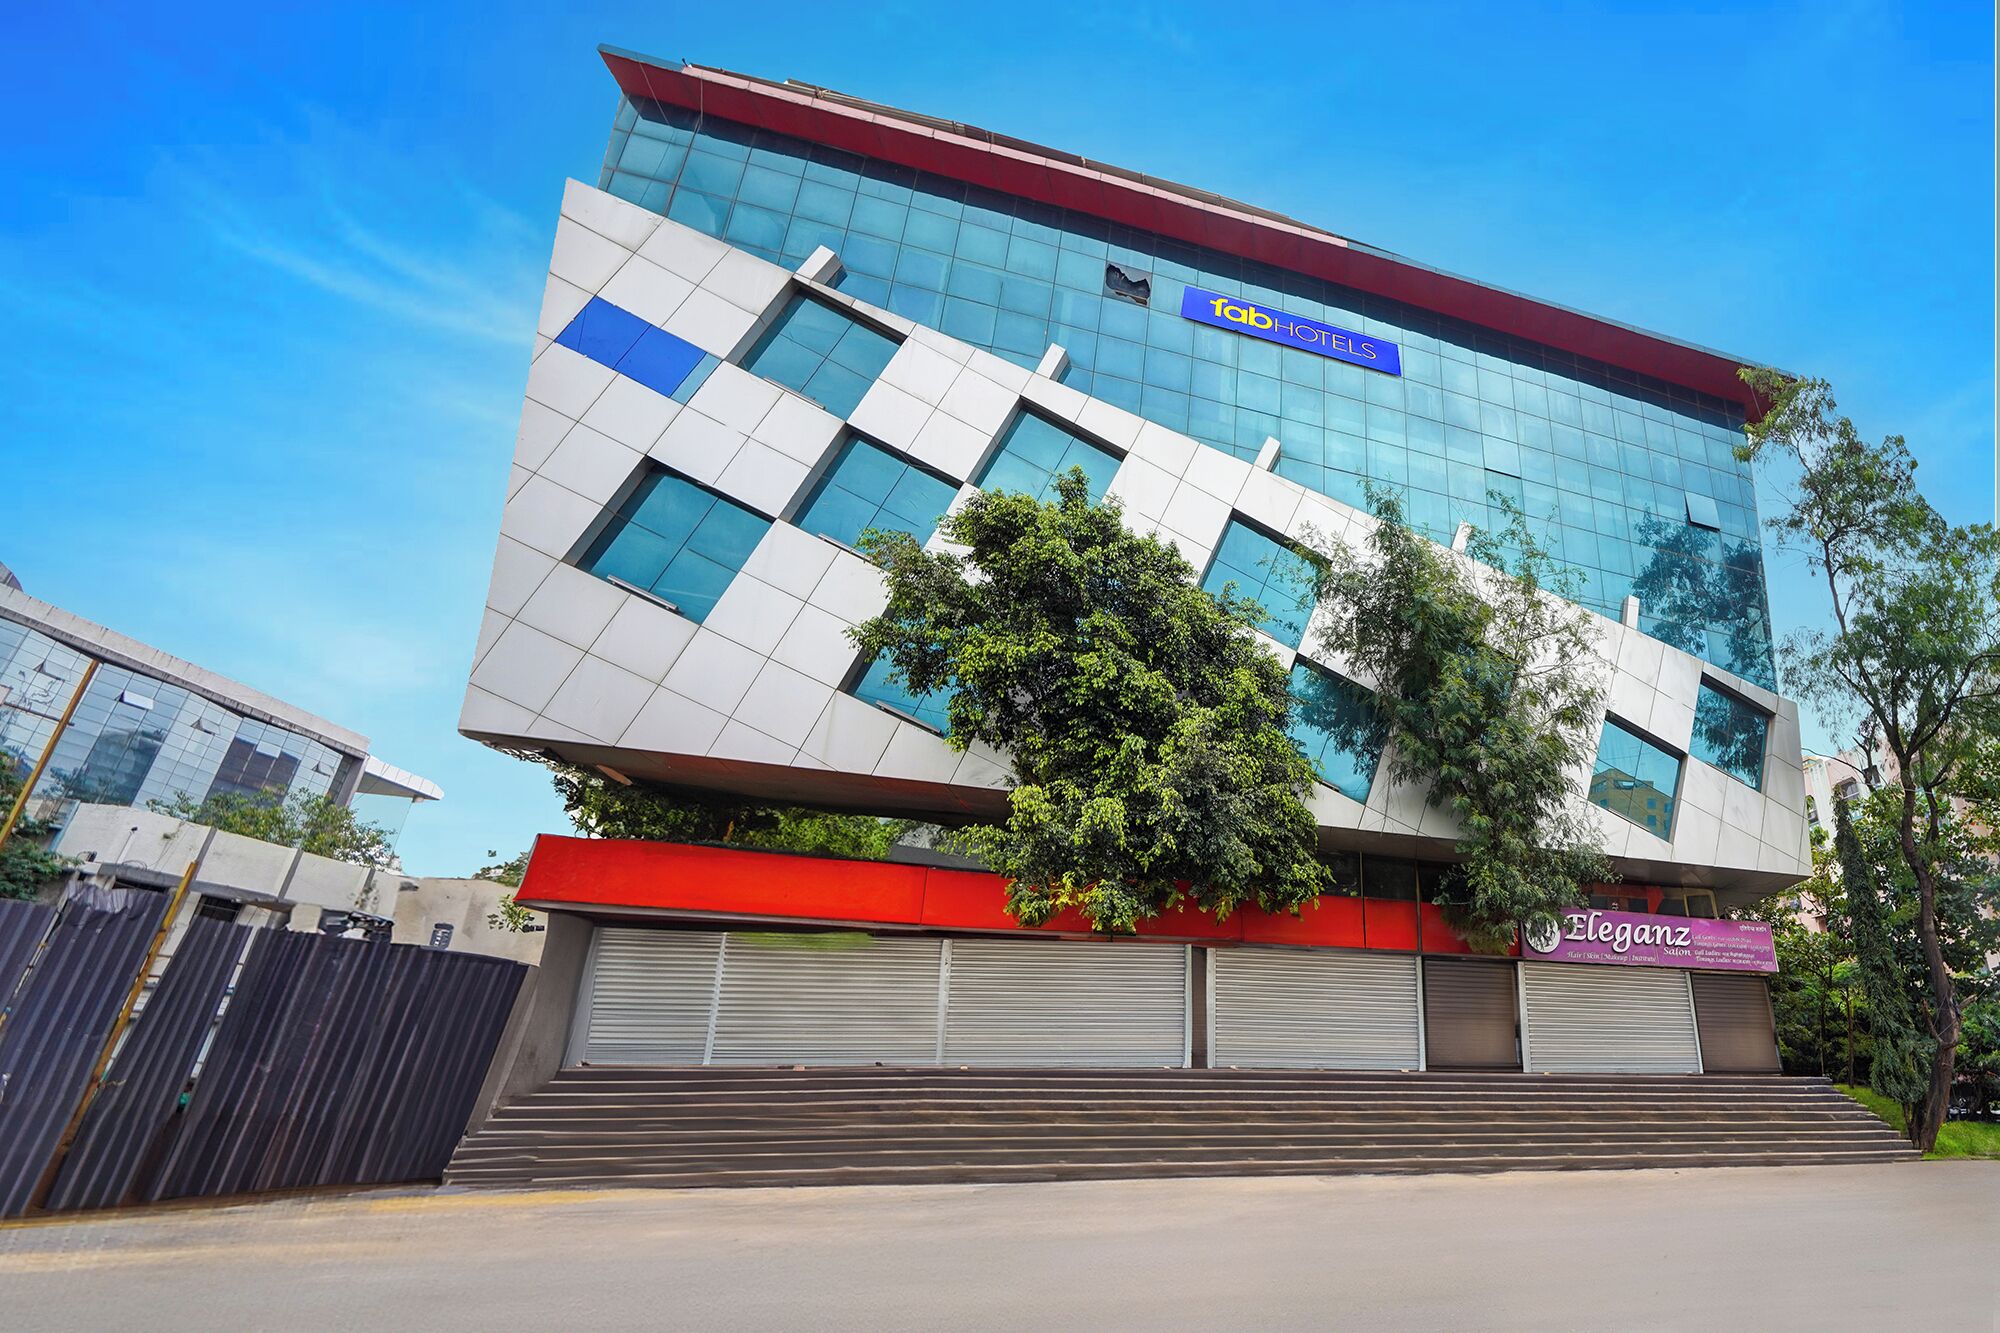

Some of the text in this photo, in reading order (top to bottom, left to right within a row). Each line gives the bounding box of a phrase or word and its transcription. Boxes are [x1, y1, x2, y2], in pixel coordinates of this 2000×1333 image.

[1564, 911, 1691, 953] Eleganz
[1567, 951, 1582, 959] Hair
[1586, 952, 1600, 960] Skin
[1663, 946, 1692, 957] Salon
